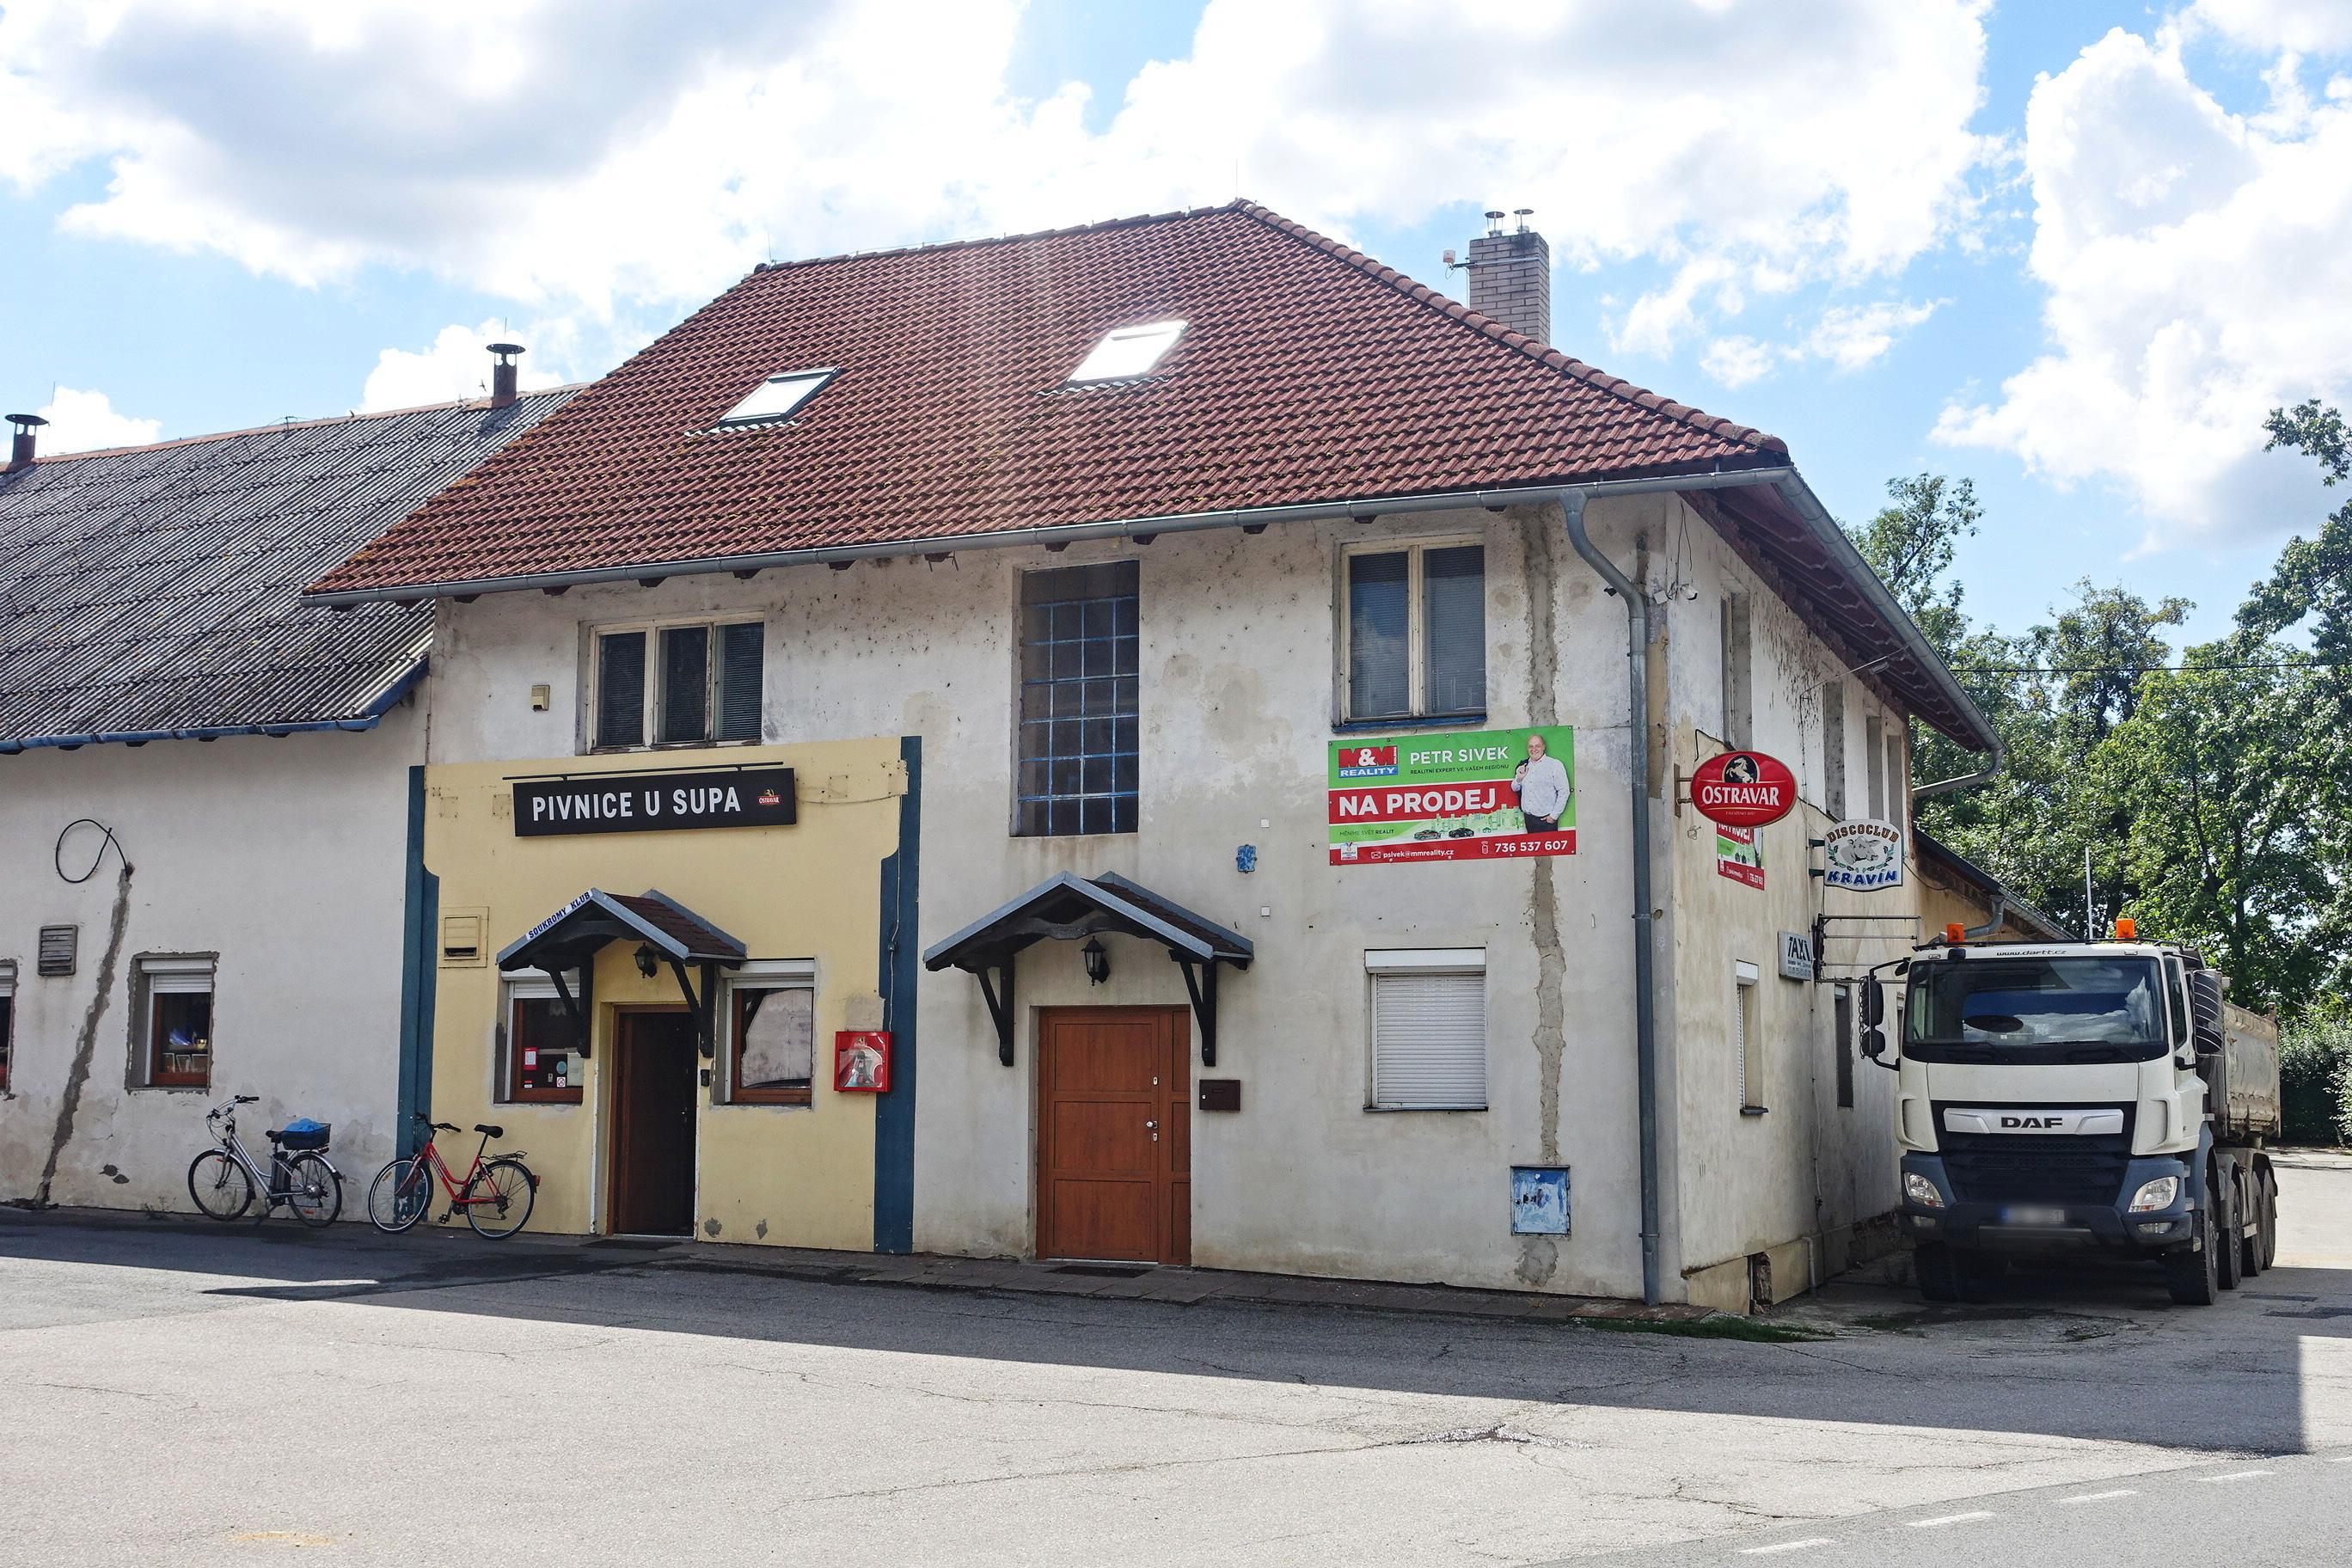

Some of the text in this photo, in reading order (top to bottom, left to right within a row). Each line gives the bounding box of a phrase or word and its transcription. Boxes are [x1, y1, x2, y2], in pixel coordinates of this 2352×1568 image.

[1338, 746, 1393, 768] M&M
[1410, 750, 1453, 765] PETR
[1458, 746, 1510, 763] SIVEK
[1340, 767, 1396, 777] REALITY
[532, 787, 742, 822] PIVNICE U SUPA
[1338, 787, 1496, 817] NA PRODEJ
[1702, 785, 1779, 806] OSTRAVAR
[1827, 824, 1899, 843] DISCOCLUB
[1383, 849, 1455, 859] psivek@mmreality.cz
[1495, 840, 1568, 854] 736 537 607
[528, 891, 591, 939] SOUKROMY KLUB
[2000, 1117, 2063, 1129] DAF
